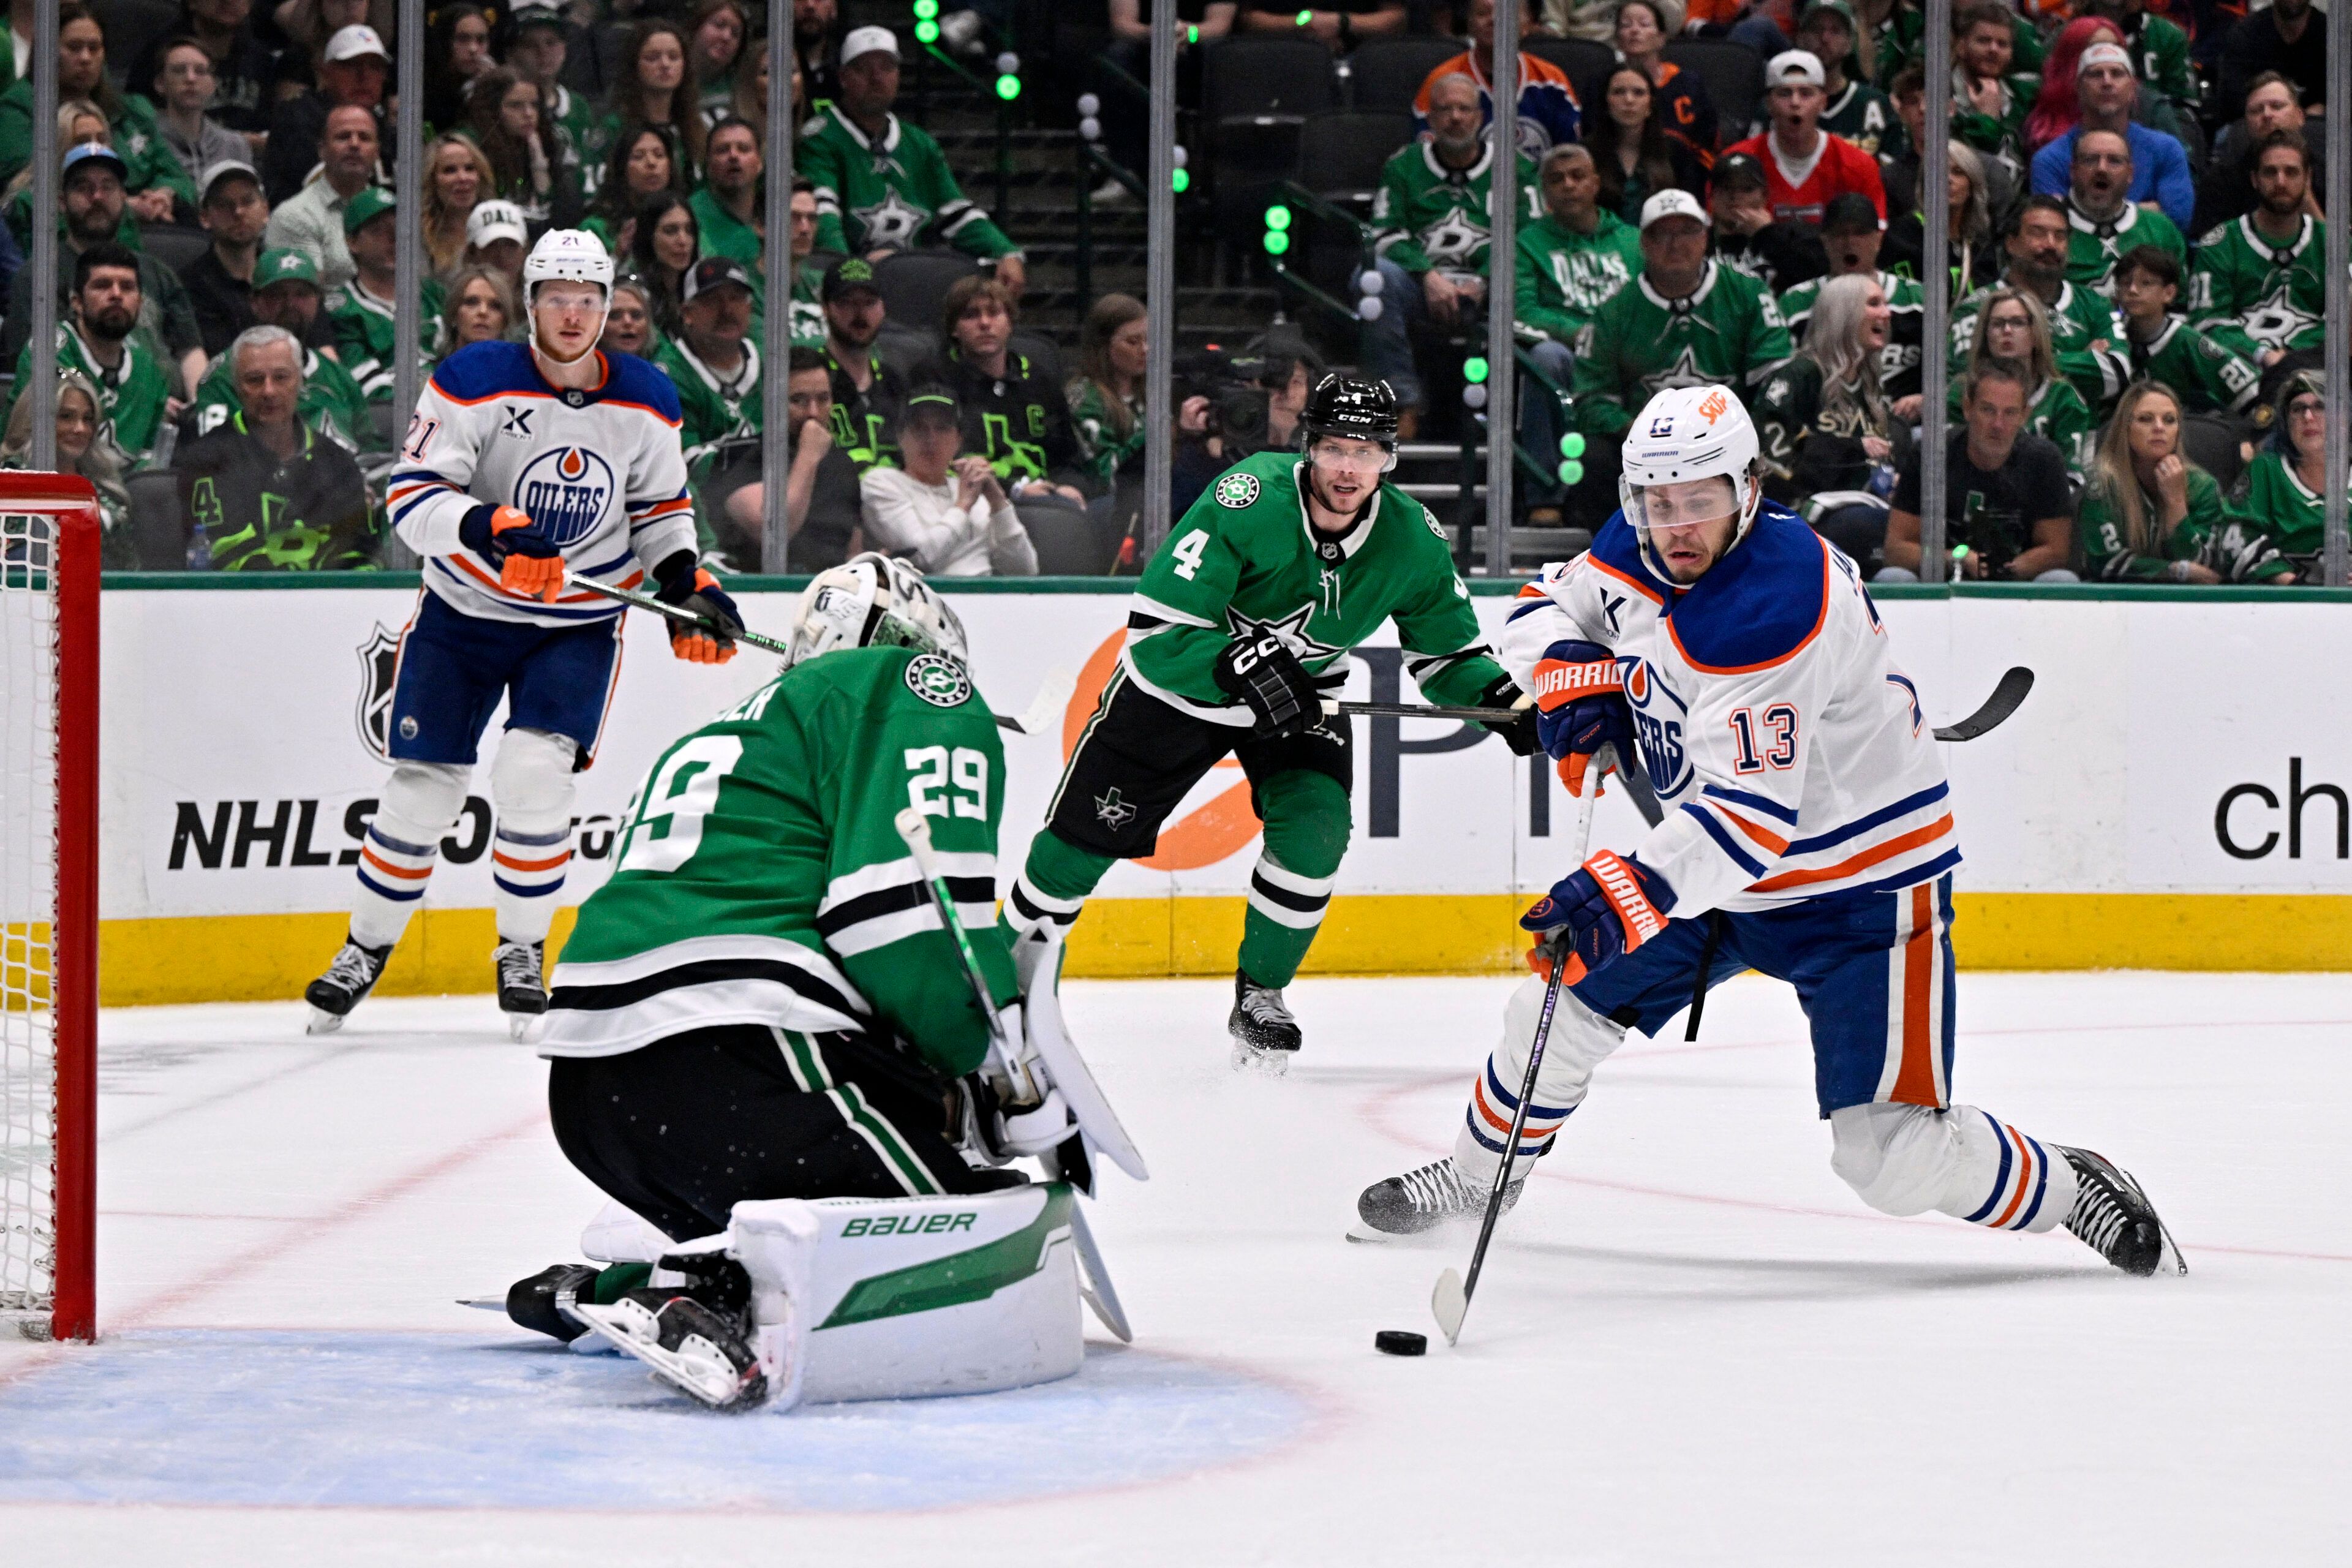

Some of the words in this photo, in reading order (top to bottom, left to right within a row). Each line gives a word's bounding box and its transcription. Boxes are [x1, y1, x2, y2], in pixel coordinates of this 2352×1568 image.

[1864, 100, 1886, 132] A
[562, 236, 579, 246] 21
[1337, 413, 1372, 424] CCM
[526, 480, 606, 519] OILERS
[1171, 528, 1210, 581] 4
[1233, 636, 1286, 675] CC
[1536, 663, 1624, 699] WARRIO
[1728, 703, 1799, 775] 13
[904, 745, 989, 823] 29
